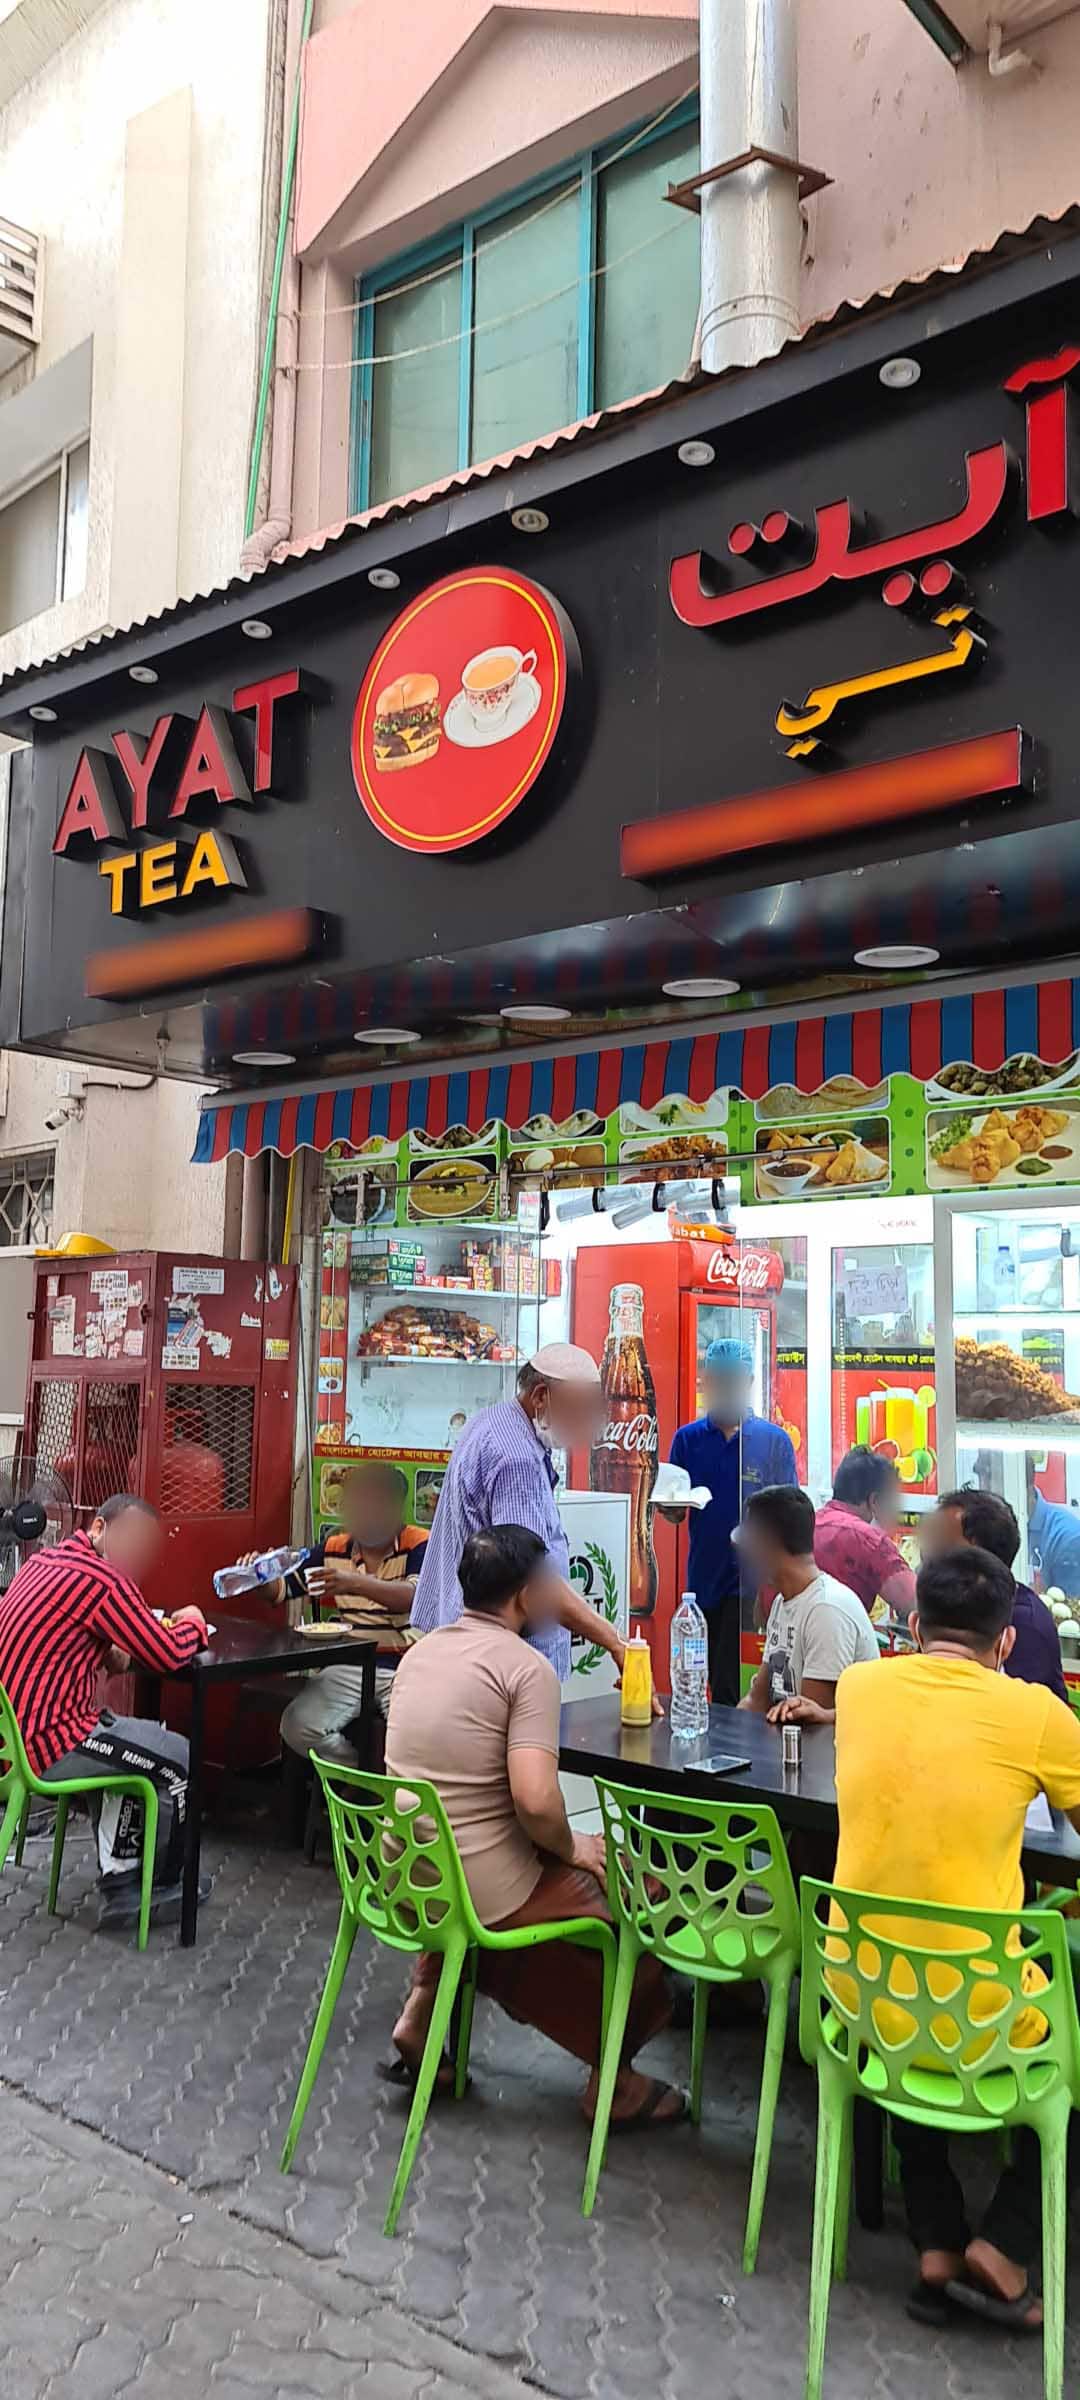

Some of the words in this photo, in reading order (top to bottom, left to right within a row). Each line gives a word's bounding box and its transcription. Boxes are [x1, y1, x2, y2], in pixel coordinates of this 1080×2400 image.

[669, 346, 1080, 627] آيت
[52, 666, 300, 854] AYAT
[774, 604, 974, 759] تي
[99, 830, 232, 915] TEA
